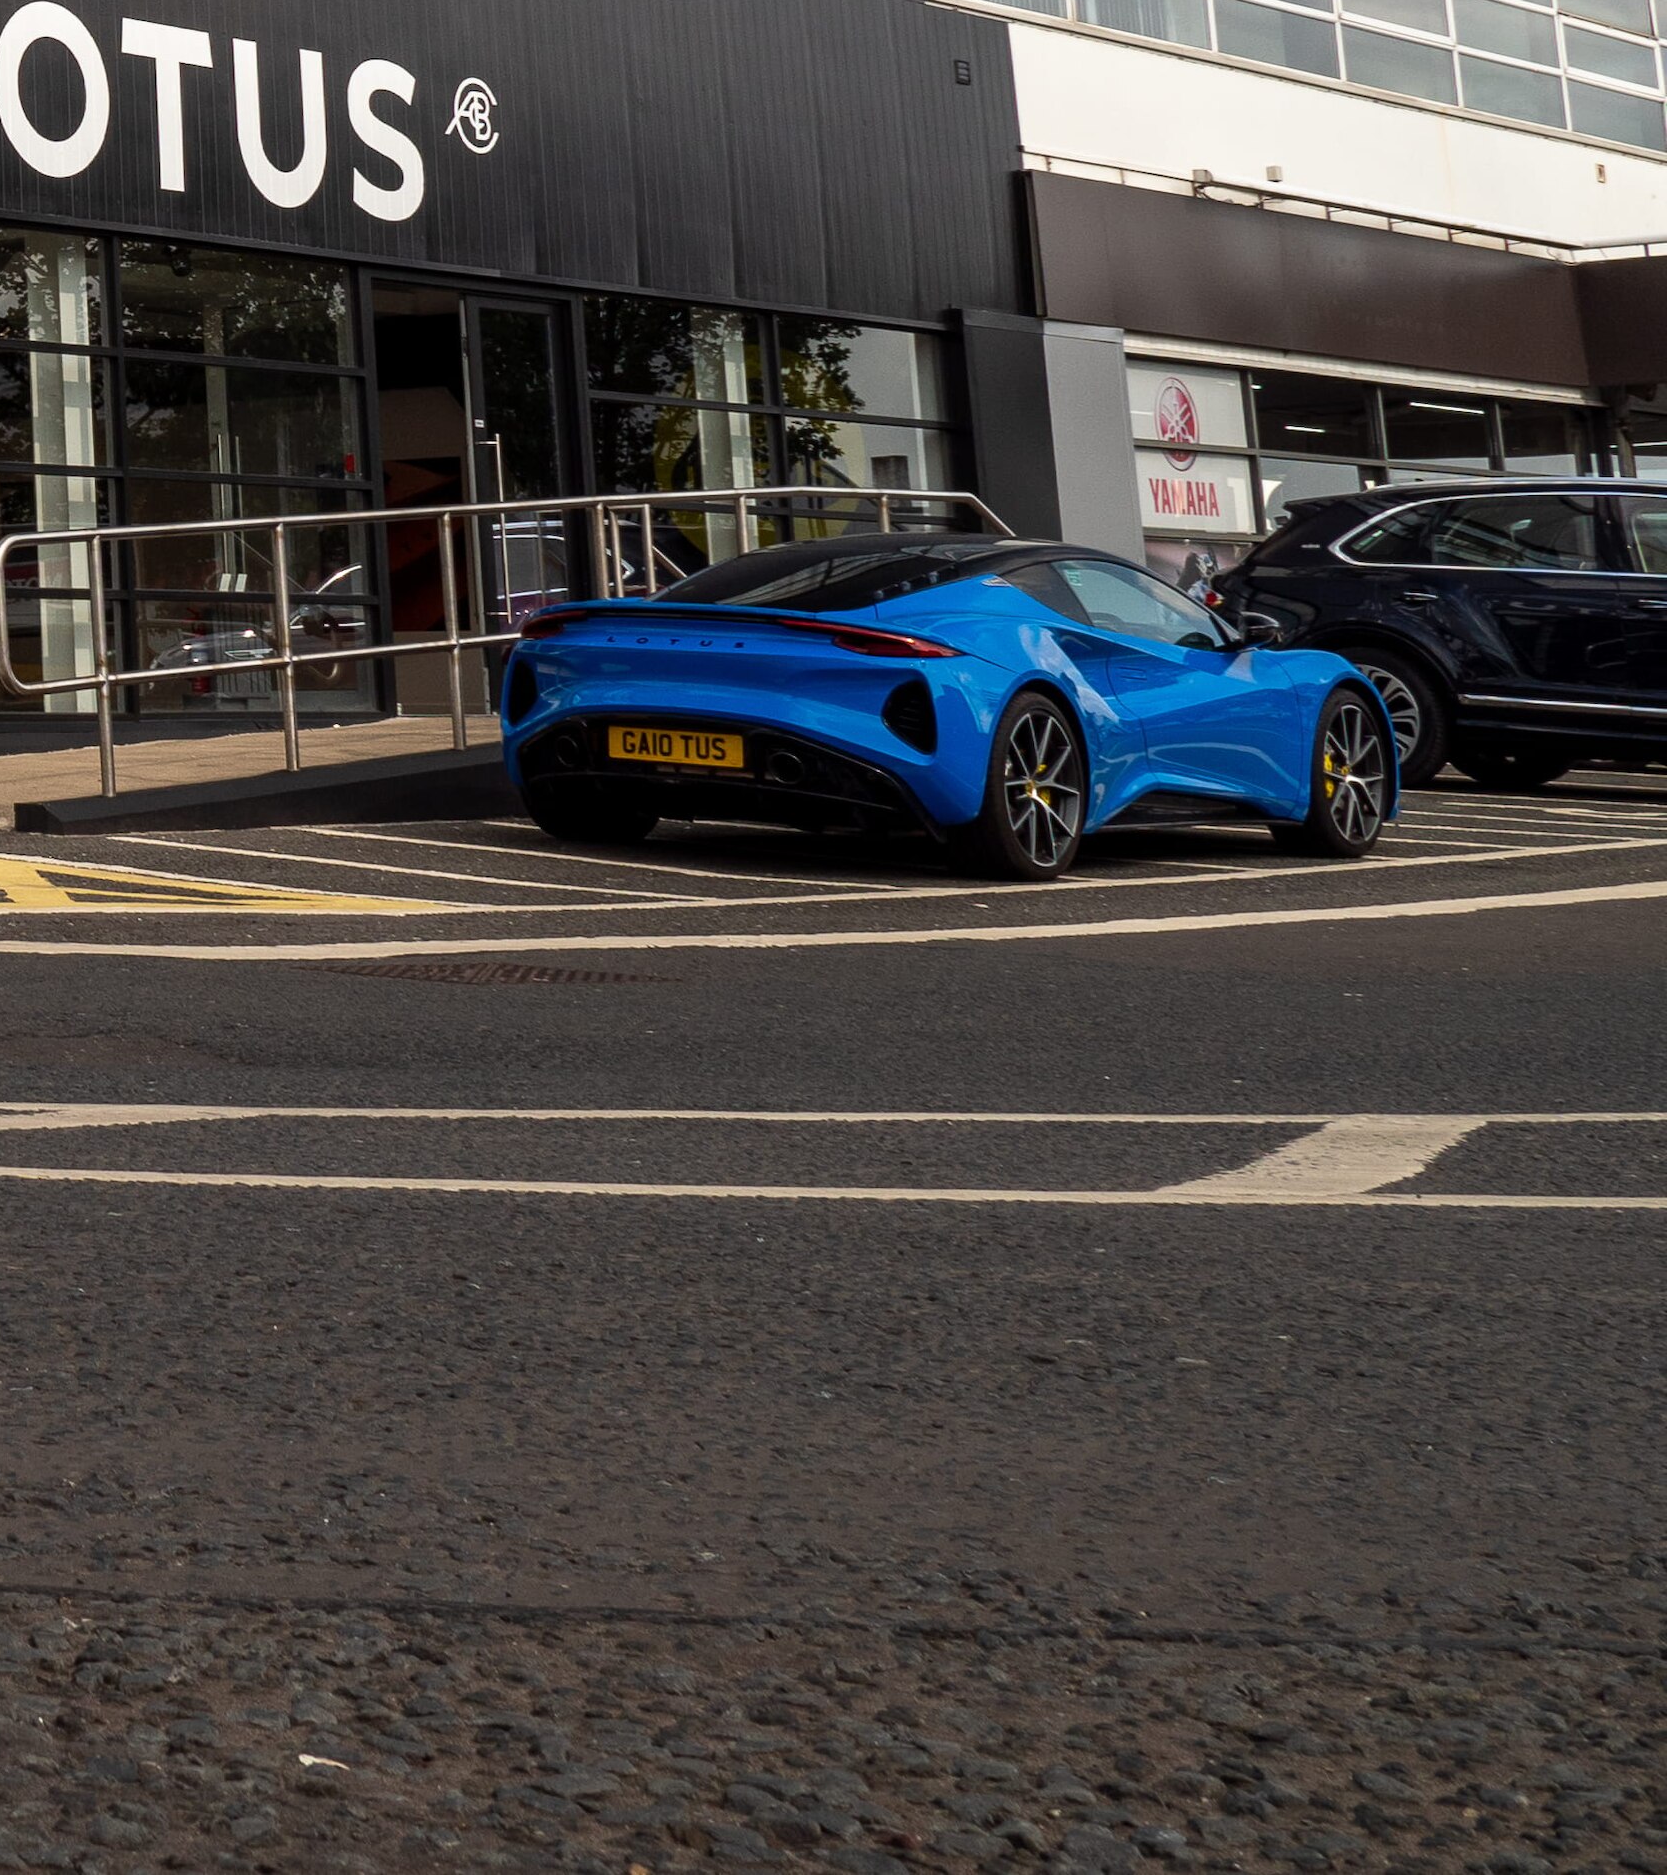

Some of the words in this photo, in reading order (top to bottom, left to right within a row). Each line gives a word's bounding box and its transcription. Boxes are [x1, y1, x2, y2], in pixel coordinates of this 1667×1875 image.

[1148, 477, 1221, 518] YAMAHA
[606, 636, 745, 649] LOTUS
[680, 734, 727, 761] TUS
